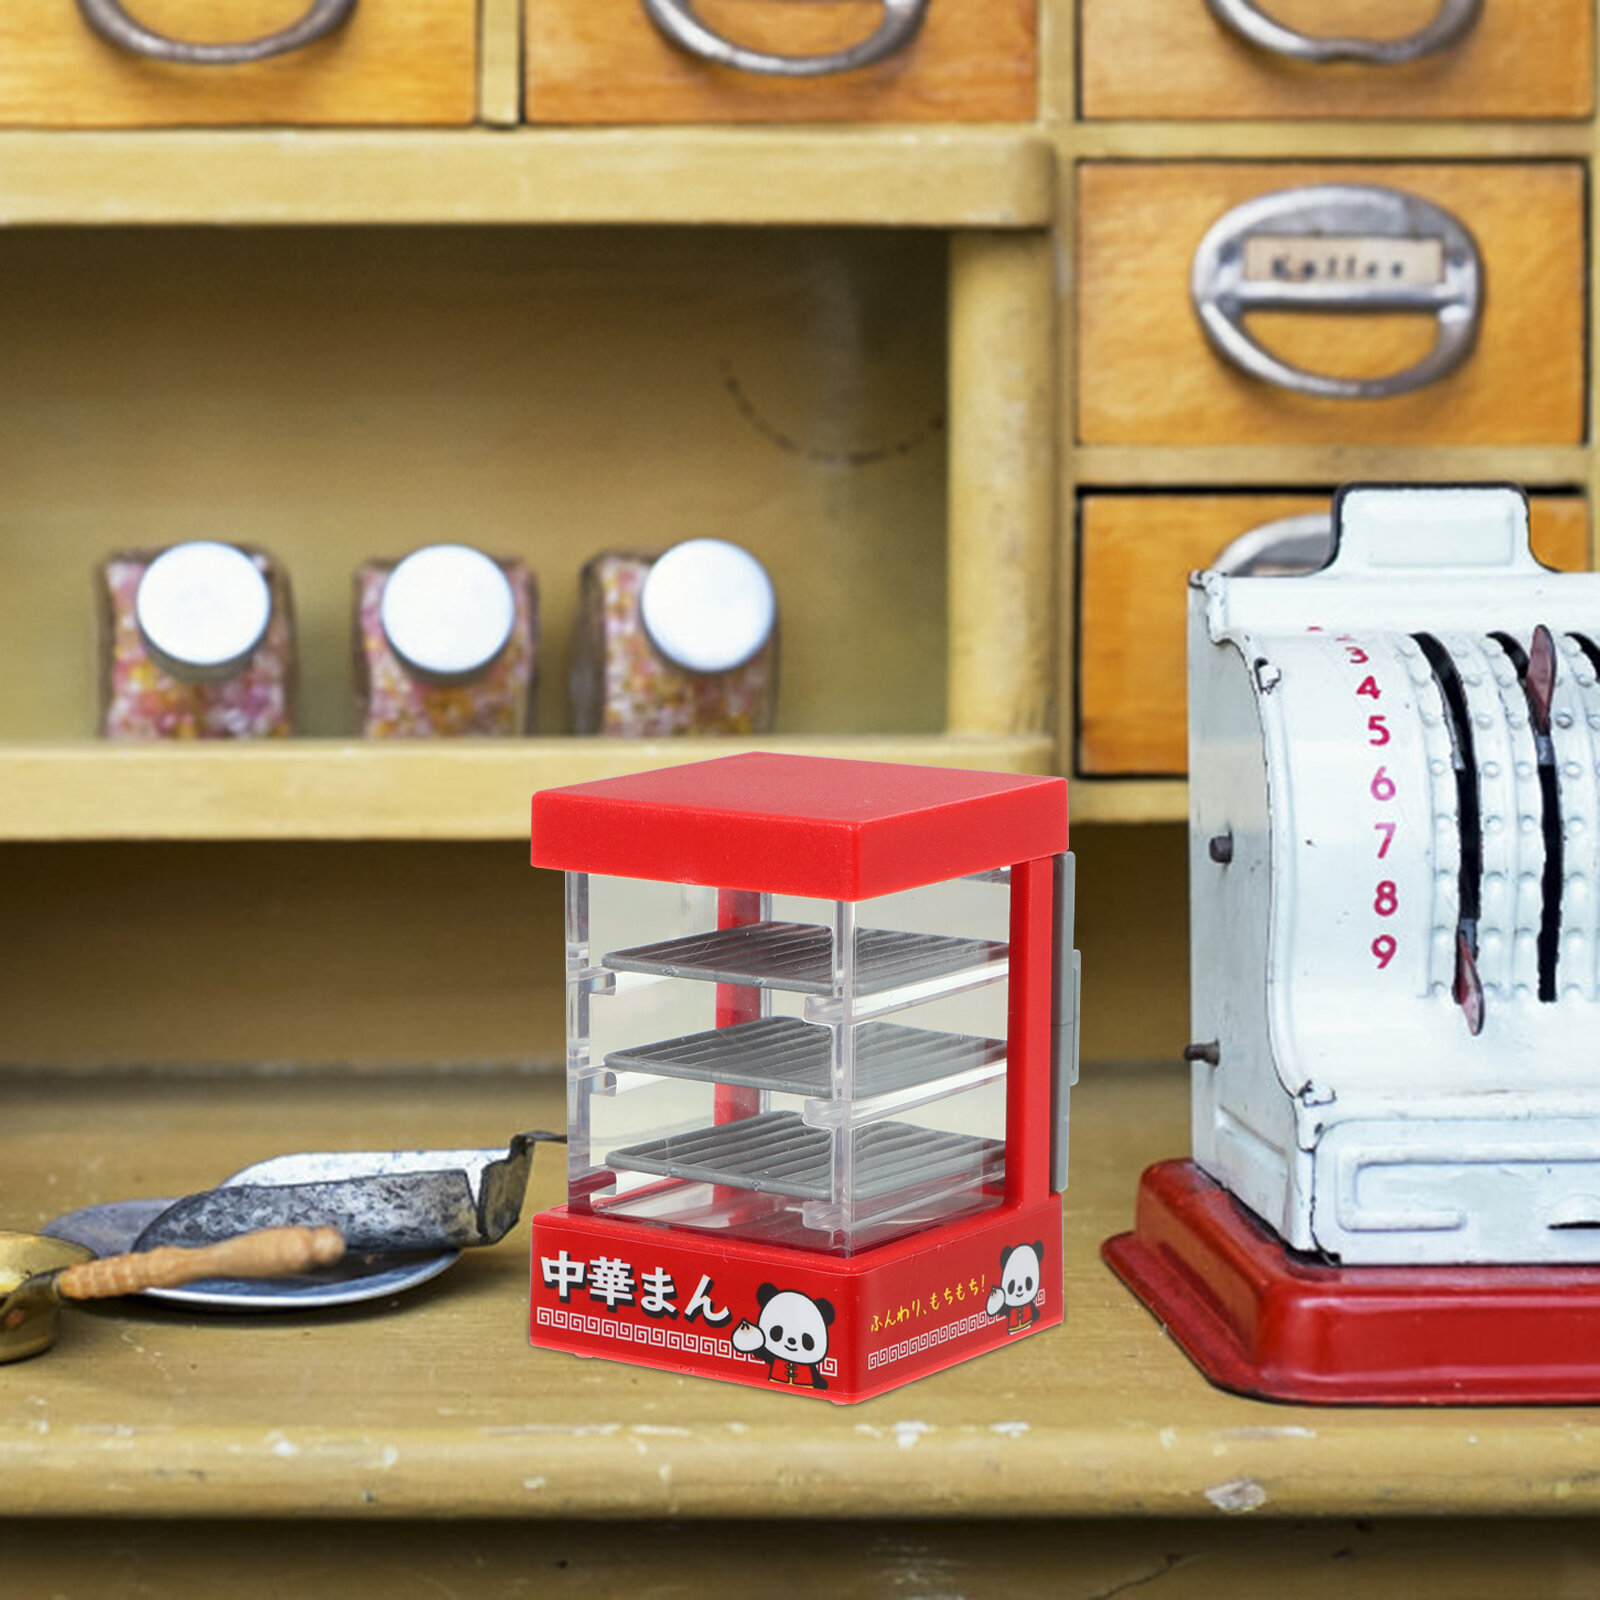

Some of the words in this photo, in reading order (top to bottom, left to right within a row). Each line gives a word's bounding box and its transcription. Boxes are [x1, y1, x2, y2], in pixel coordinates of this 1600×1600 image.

[1345, 646, 1369, 664] 3
[1356, 675, 1381, 699] 4
[1367, 715, 1390, 746] 5
[1370, 766, 1396, 801] 6
[1374, 822, 1397, 859] 7
[1373, 880, 1398, 916] 8
[1371, 934, 1397, 969] 9
[540, 1250, 731, 1324] 中華まん
